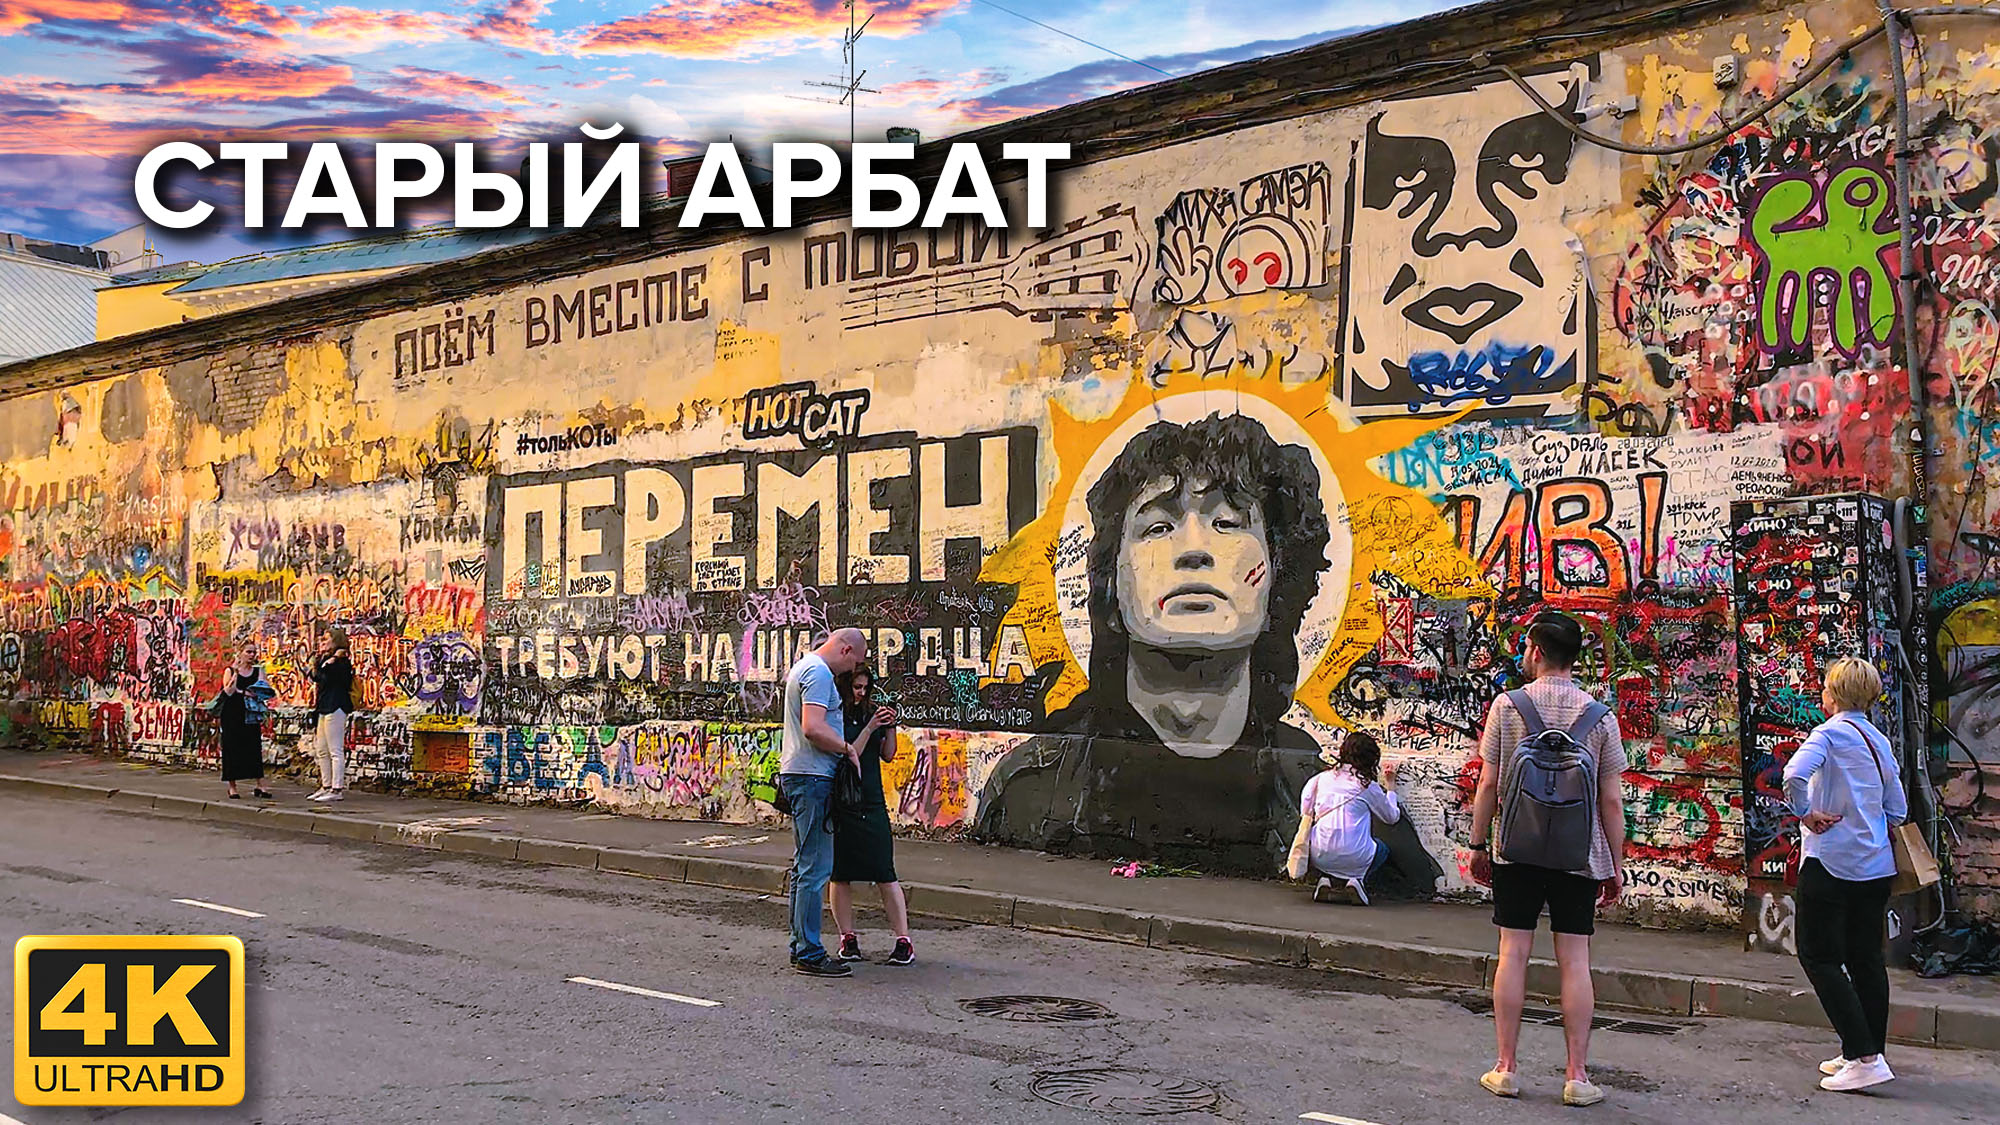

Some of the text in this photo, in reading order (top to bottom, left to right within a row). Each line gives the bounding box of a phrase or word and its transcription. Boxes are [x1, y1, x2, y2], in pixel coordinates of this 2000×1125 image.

[394, 307, 496, 380] ПОЁМ
[525, 264, 709, 349] ВМЕСТЕ
[742, 246, 771, 304] С
[748, 388, 810, 433] HOT
[803, 397, 866, 441] CAT
[503, 436, 1010, 599] ПЕРЕМЕН
[1747, 578, 1792, 592] КНО
[496, 633, 668, 683] ТРЕБУЮТ
